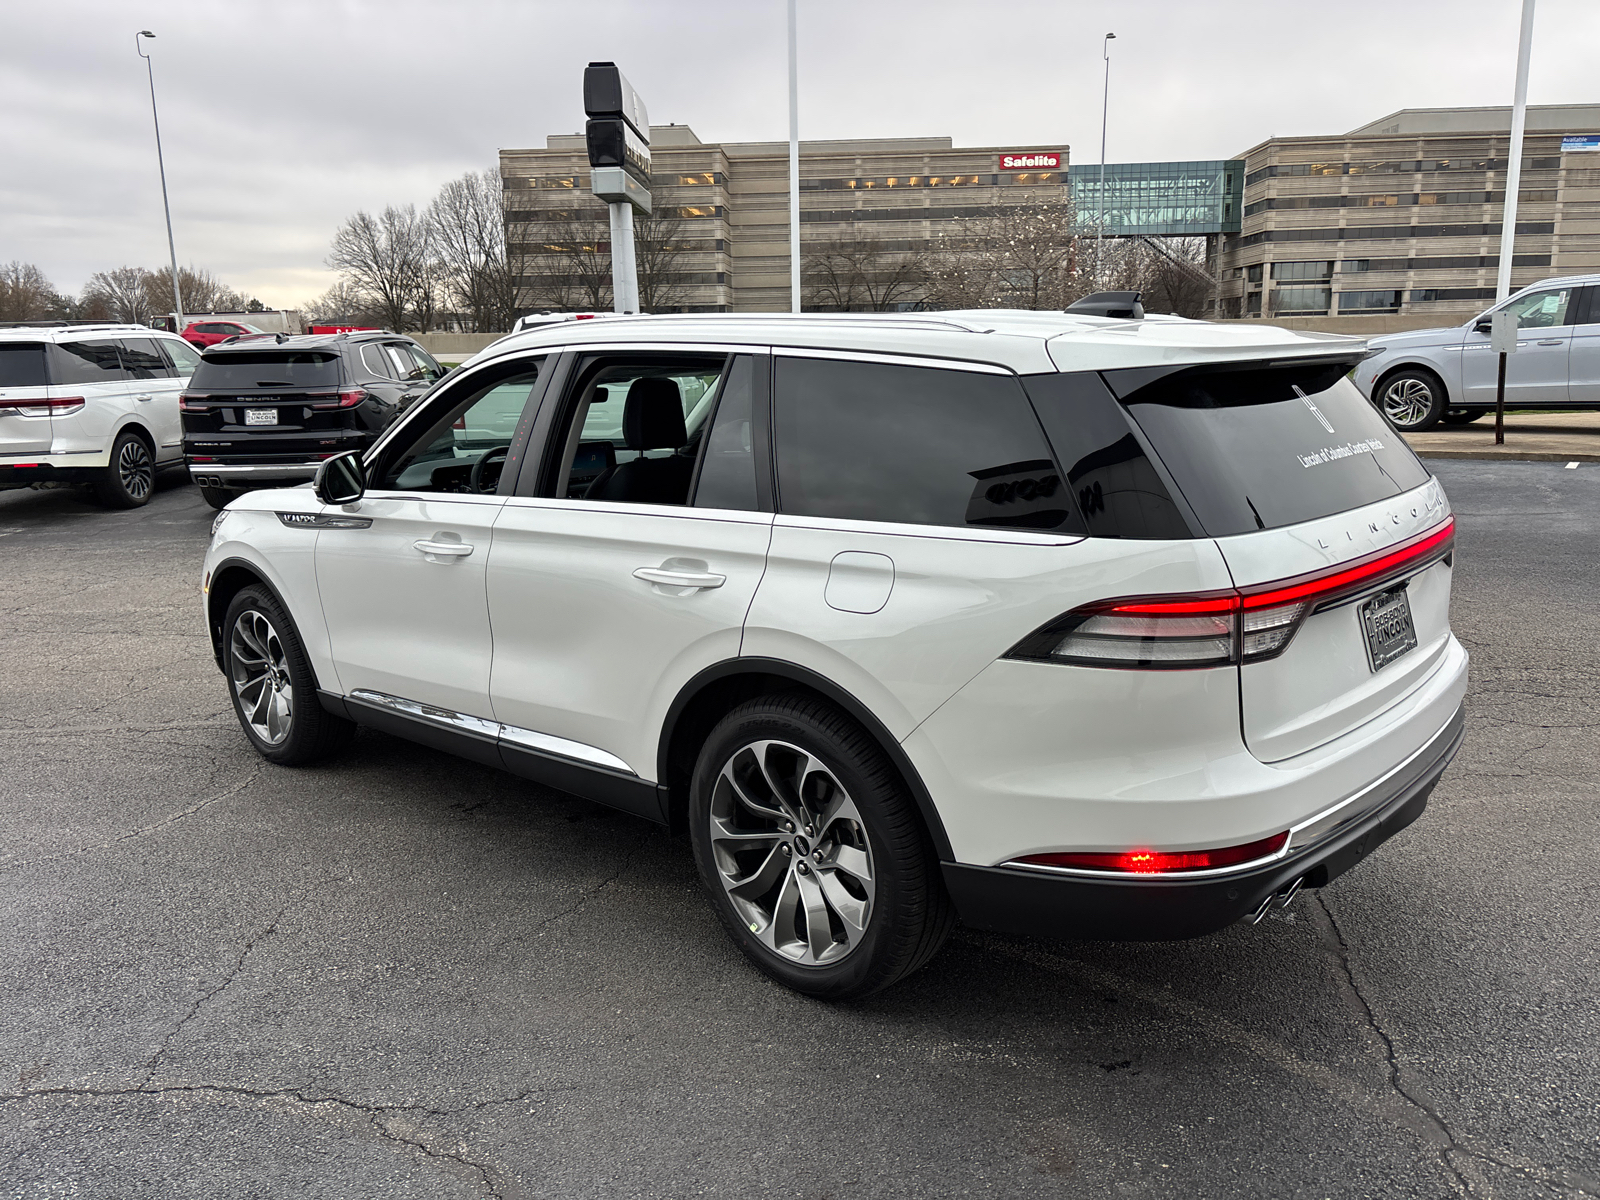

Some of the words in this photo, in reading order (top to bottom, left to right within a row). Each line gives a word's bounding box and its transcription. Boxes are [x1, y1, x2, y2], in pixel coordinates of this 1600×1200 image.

[1003, 155, 1057, 168] Safelite
[1297, 451, 1324, 468] Lincoln
[1324, 444, 1354, 461] Columbus
[1365, 438, 1385, 451] Vehicle
[1318, 497, 1442, 549] LINCOLN
[1375, 613, 1410, 644] LINCOLN
